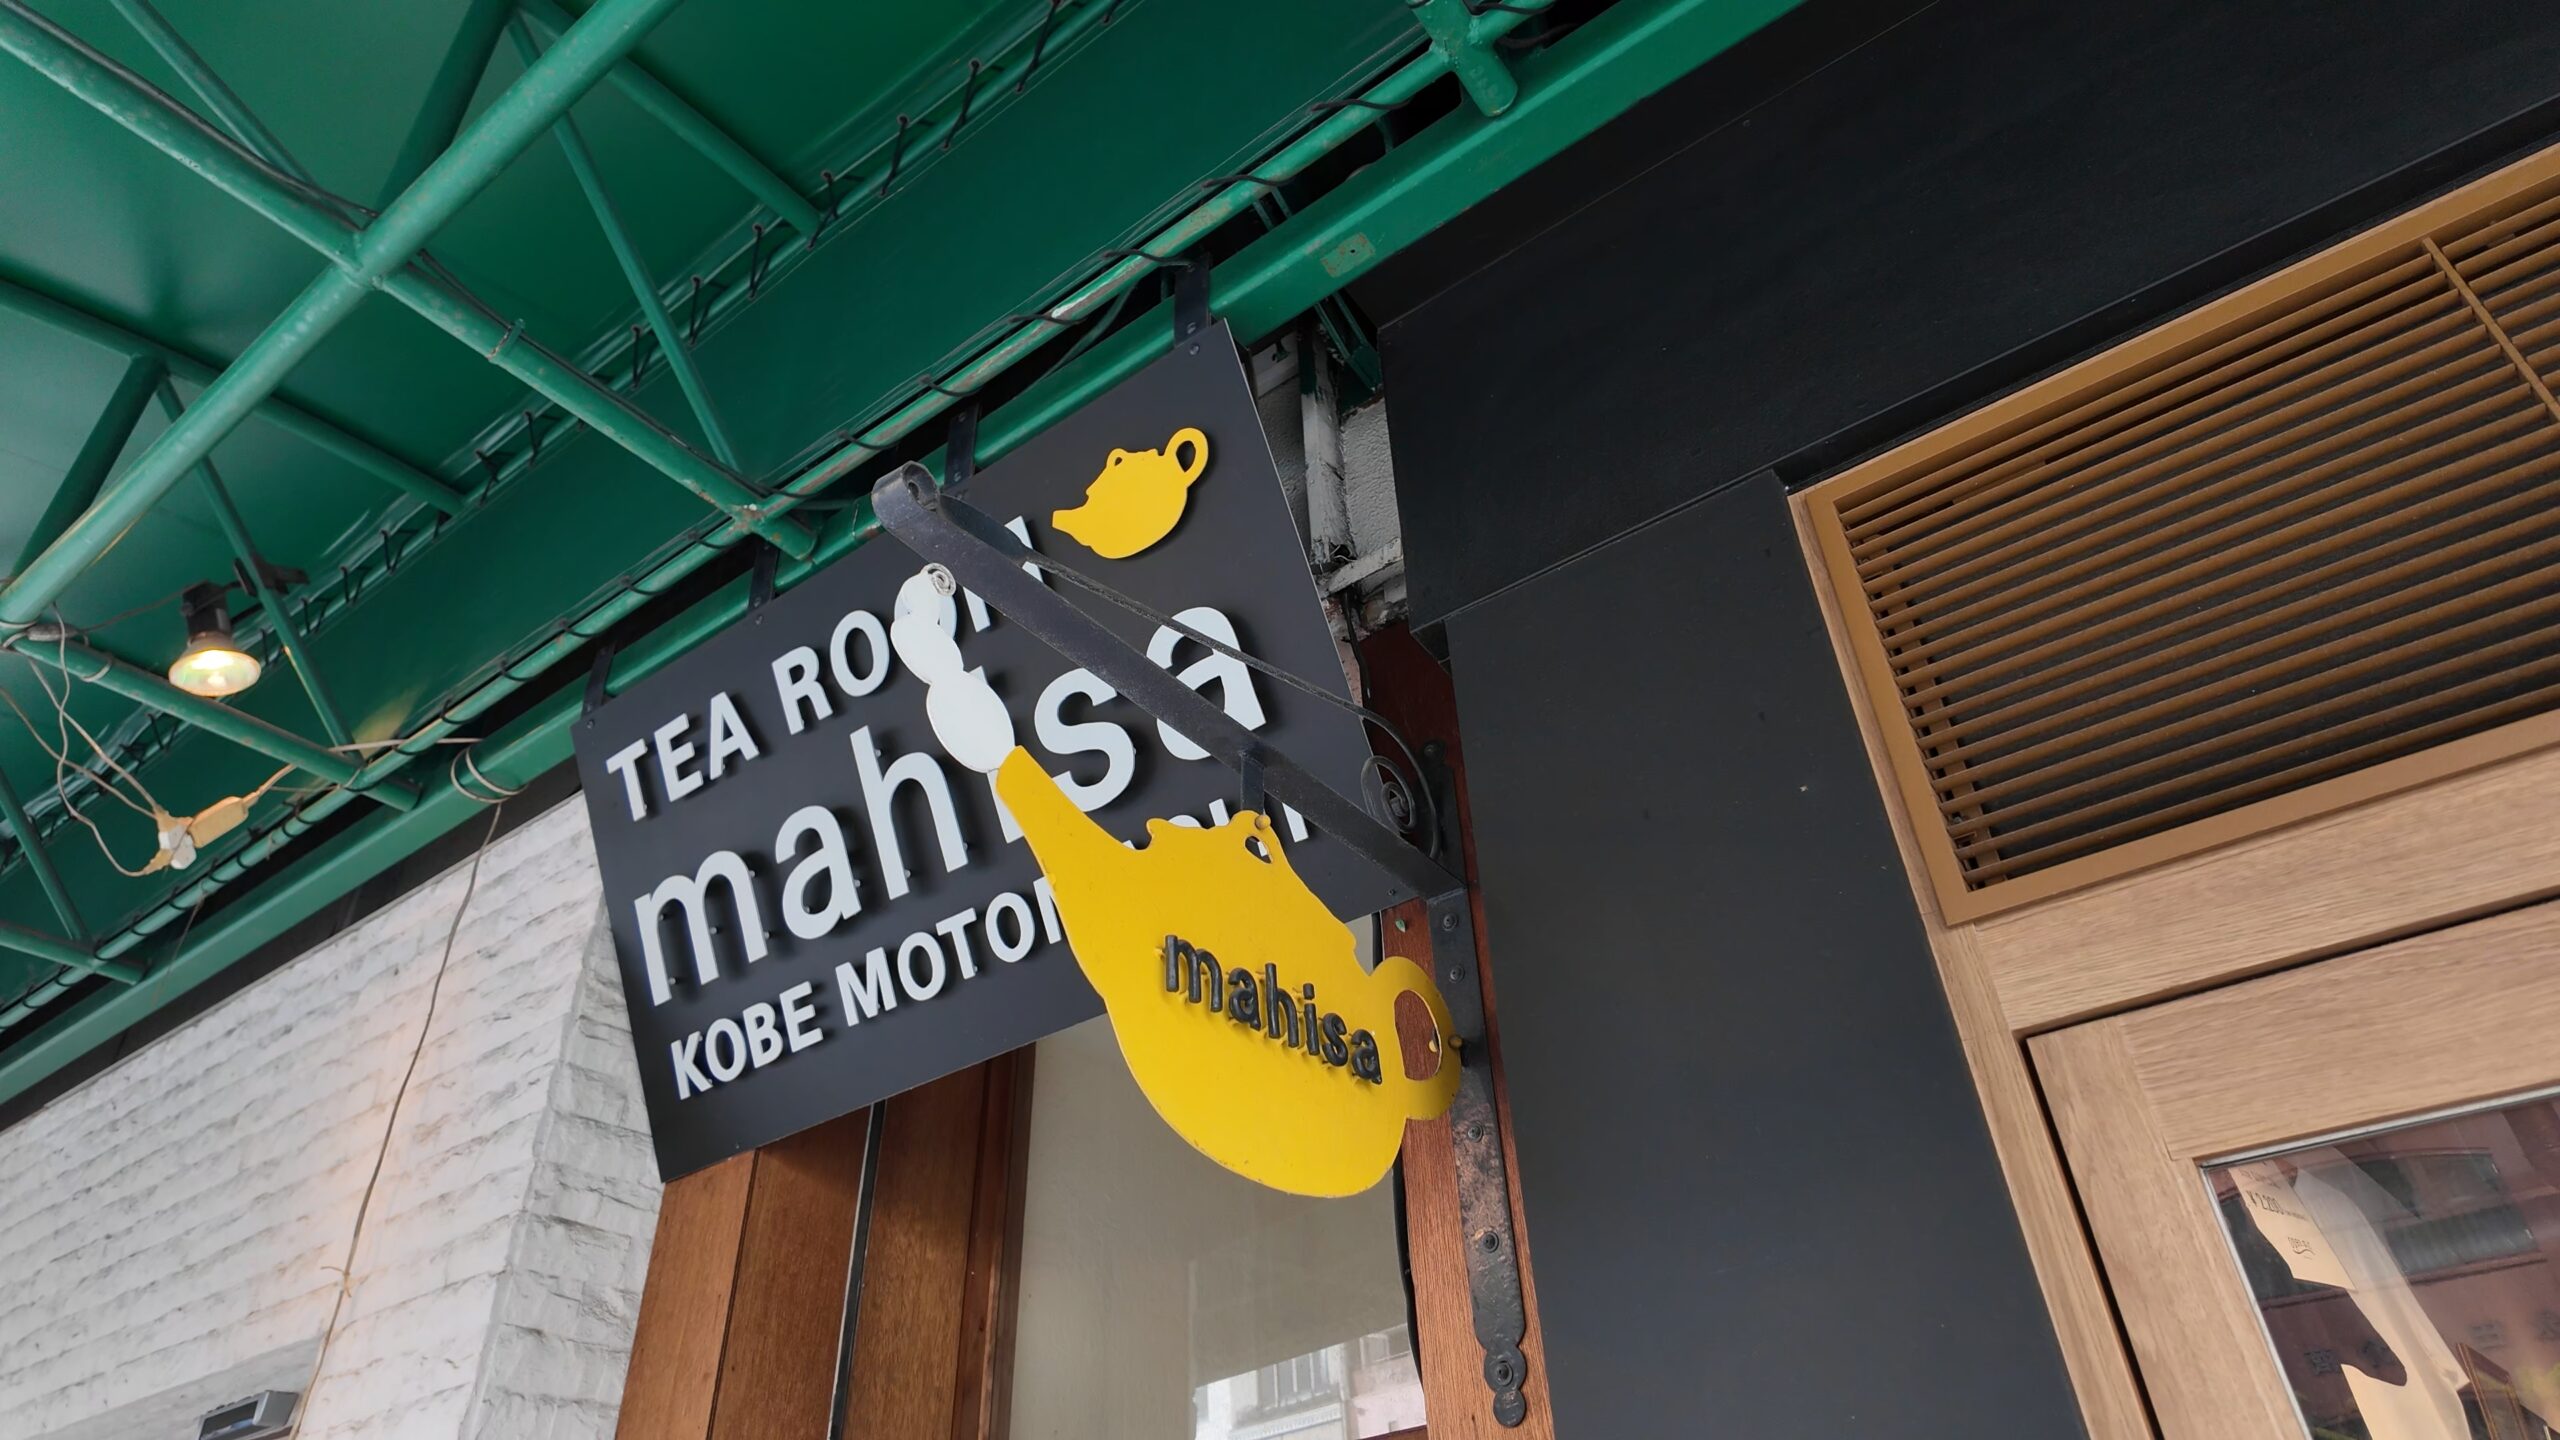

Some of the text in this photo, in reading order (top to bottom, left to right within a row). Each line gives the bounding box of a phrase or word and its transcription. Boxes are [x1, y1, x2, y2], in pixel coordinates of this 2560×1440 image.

[606, 692, 760, 822] TEA
[670, 981, 824, 1100] KOBE
[1164, 934, 1382, 1085] mahisa
